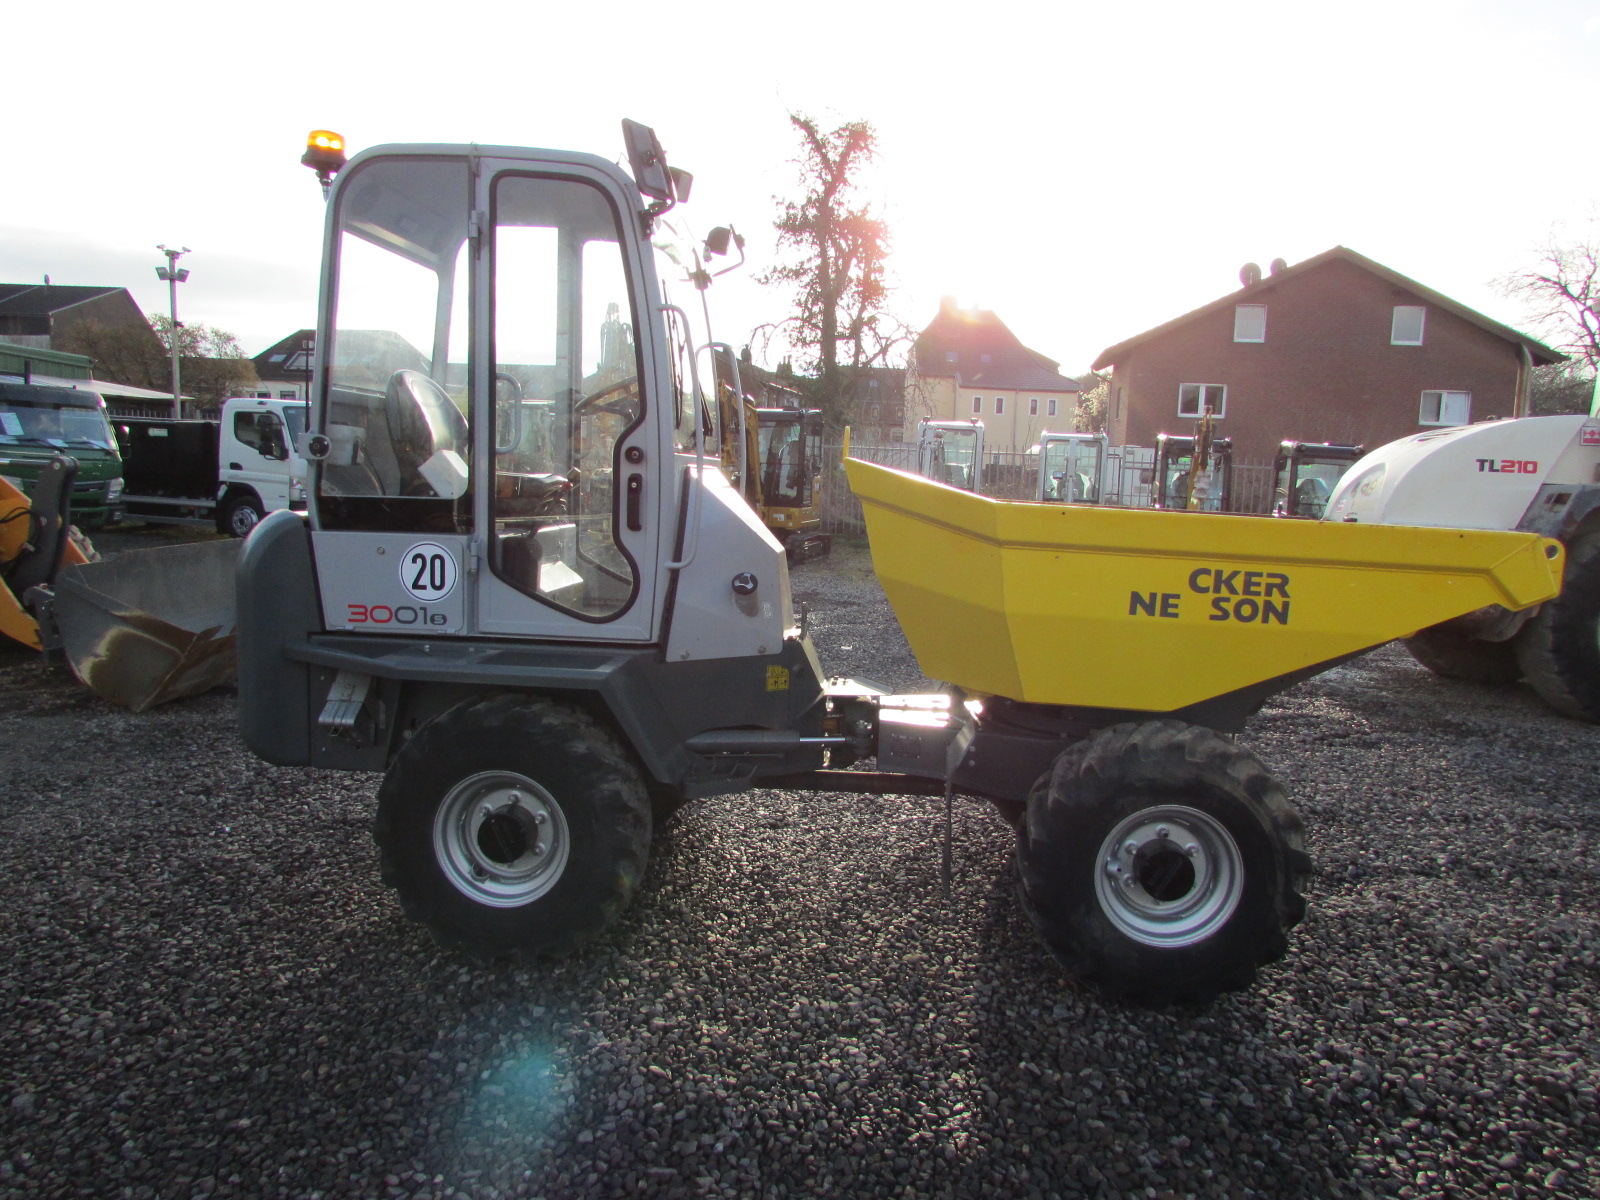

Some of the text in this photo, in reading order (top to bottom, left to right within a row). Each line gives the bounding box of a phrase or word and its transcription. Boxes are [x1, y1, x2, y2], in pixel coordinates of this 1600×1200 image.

[1475, 458, 1538, 474] TL210
[411, 552, 446, 592] 20
[1188, 567, 1291, 599] CKER
